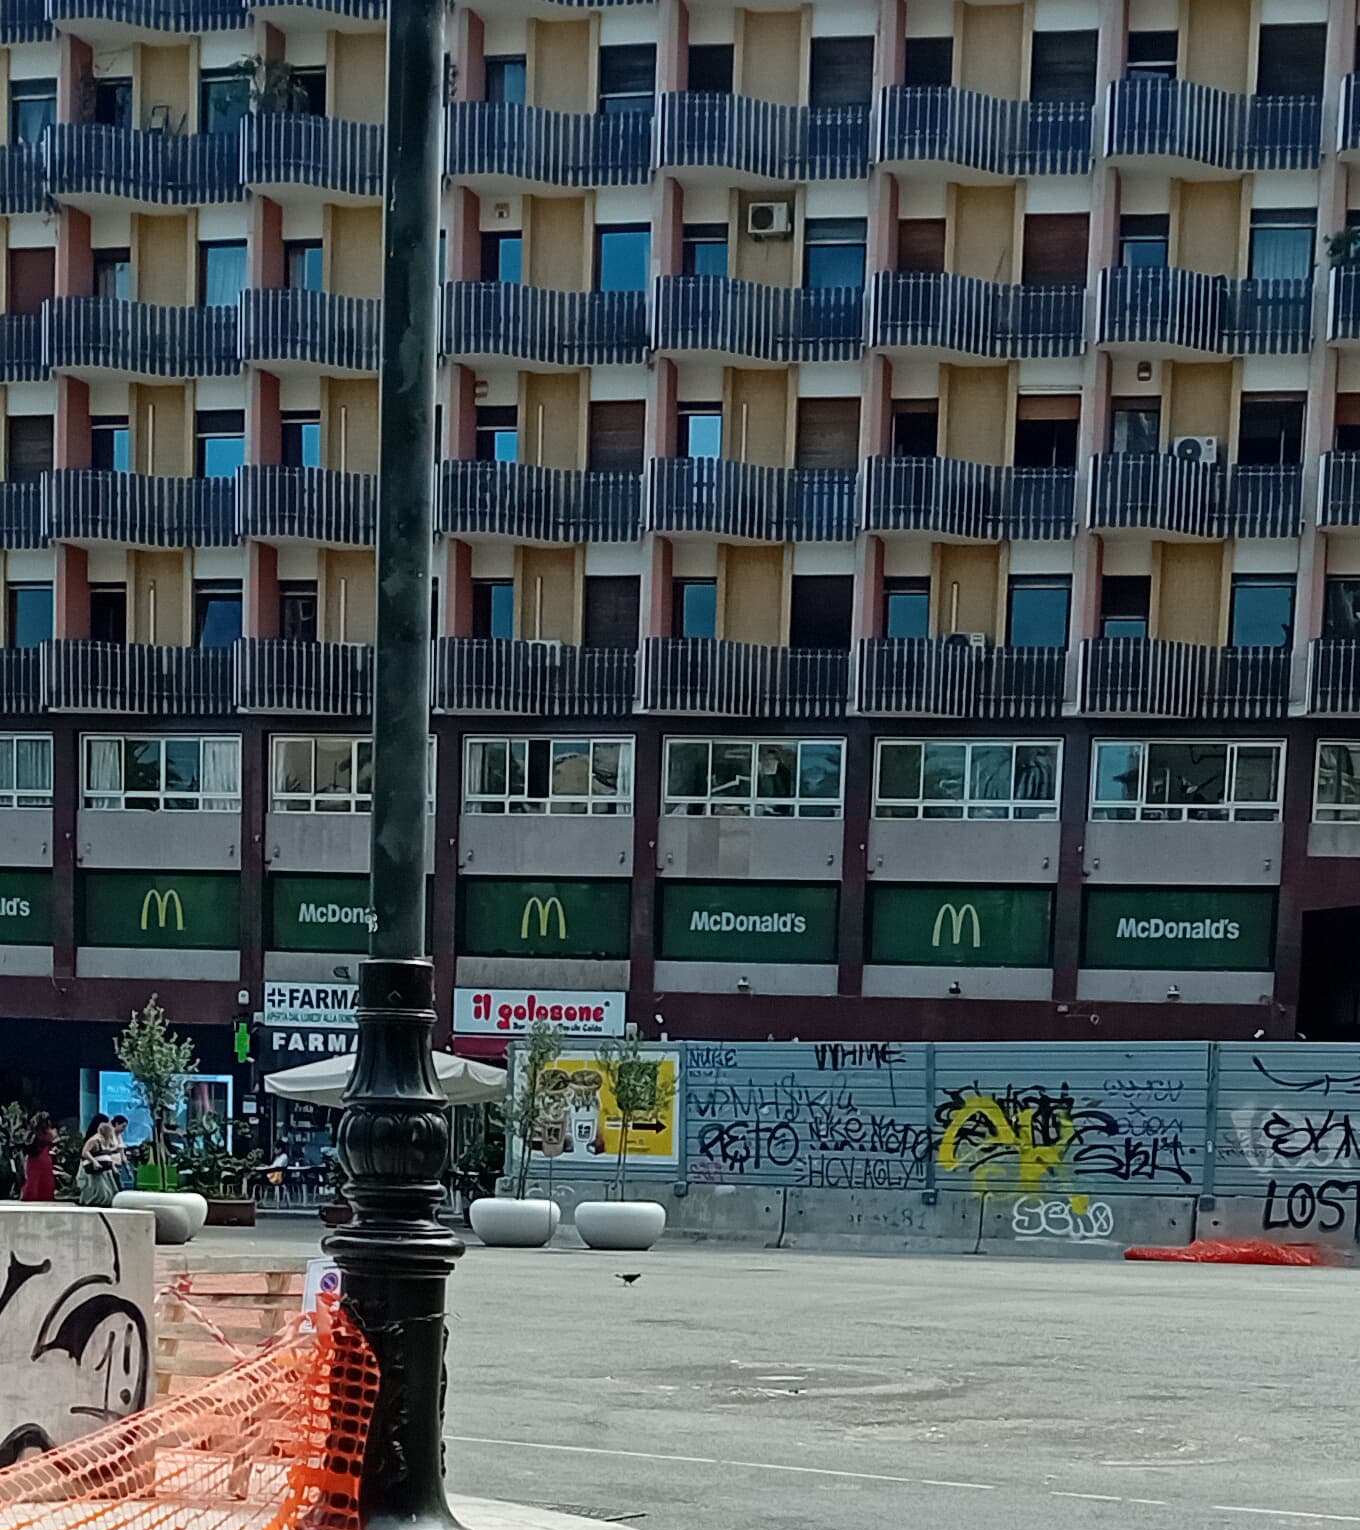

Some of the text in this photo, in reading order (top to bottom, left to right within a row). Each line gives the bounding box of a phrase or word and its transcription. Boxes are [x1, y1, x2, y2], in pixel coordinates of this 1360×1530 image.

[689, 910, 807, 933] McDonald's
[1116, 917, 1240, 939] McDonald's
[472, 993, 605, 1030] il golosone
